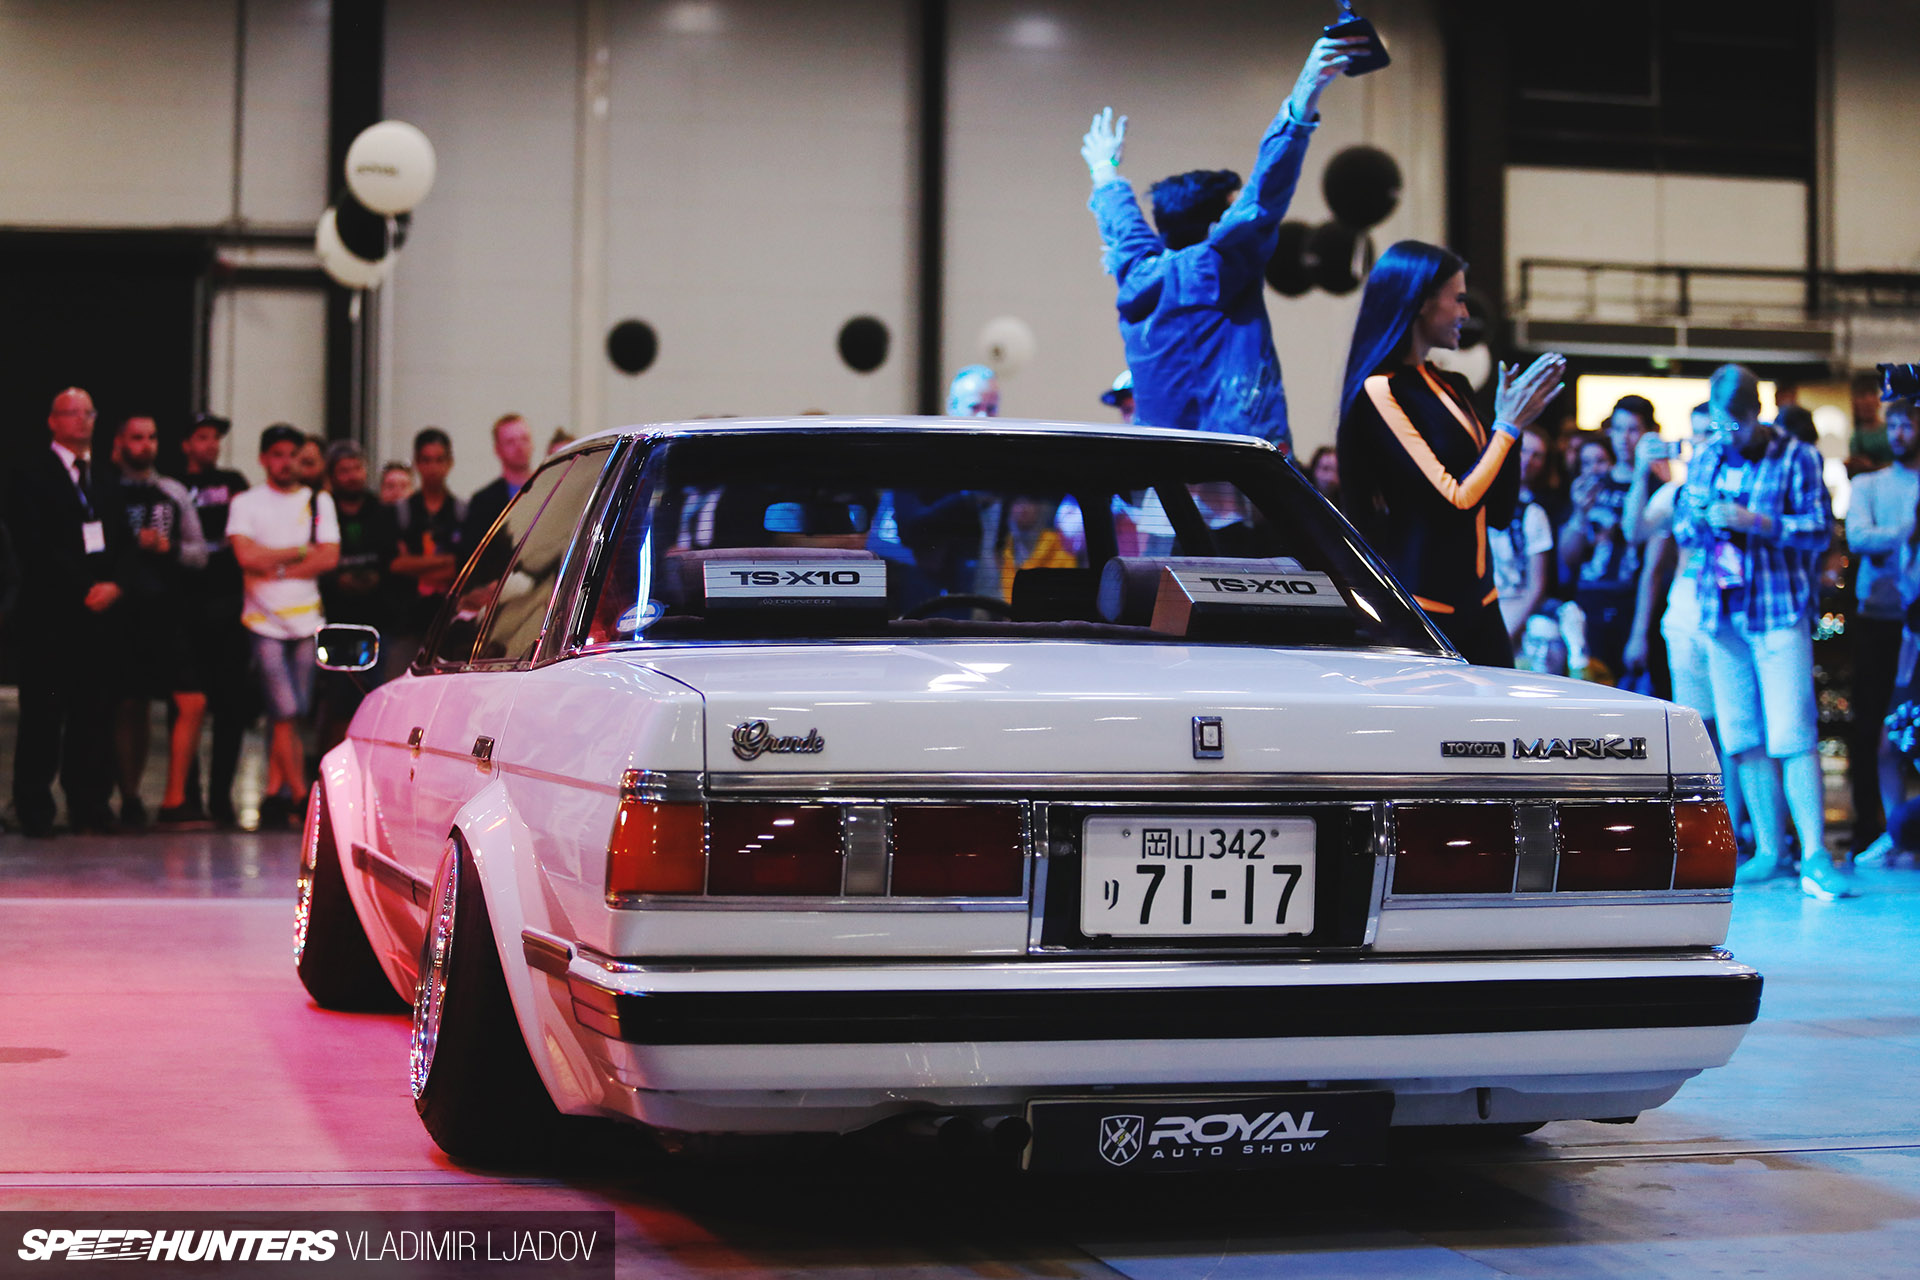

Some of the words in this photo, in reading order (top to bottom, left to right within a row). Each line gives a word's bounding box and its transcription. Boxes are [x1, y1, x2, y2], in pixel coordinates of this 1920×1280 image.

[730, 571, 860, 586] TS-X10
[1200, 577, 1317, 595] TS-X10
[732, 720, 825, 761] Grande
[1447, 743, 1501, 755] TOYOTA
[1136, 864, 1302, 925] 71-17
[1148, 1111, 1330, 1145] ROYAL
[1152, 1146, 1223, 1159] AUTO
[1242, 1142, 1317, 1154] SHOW
